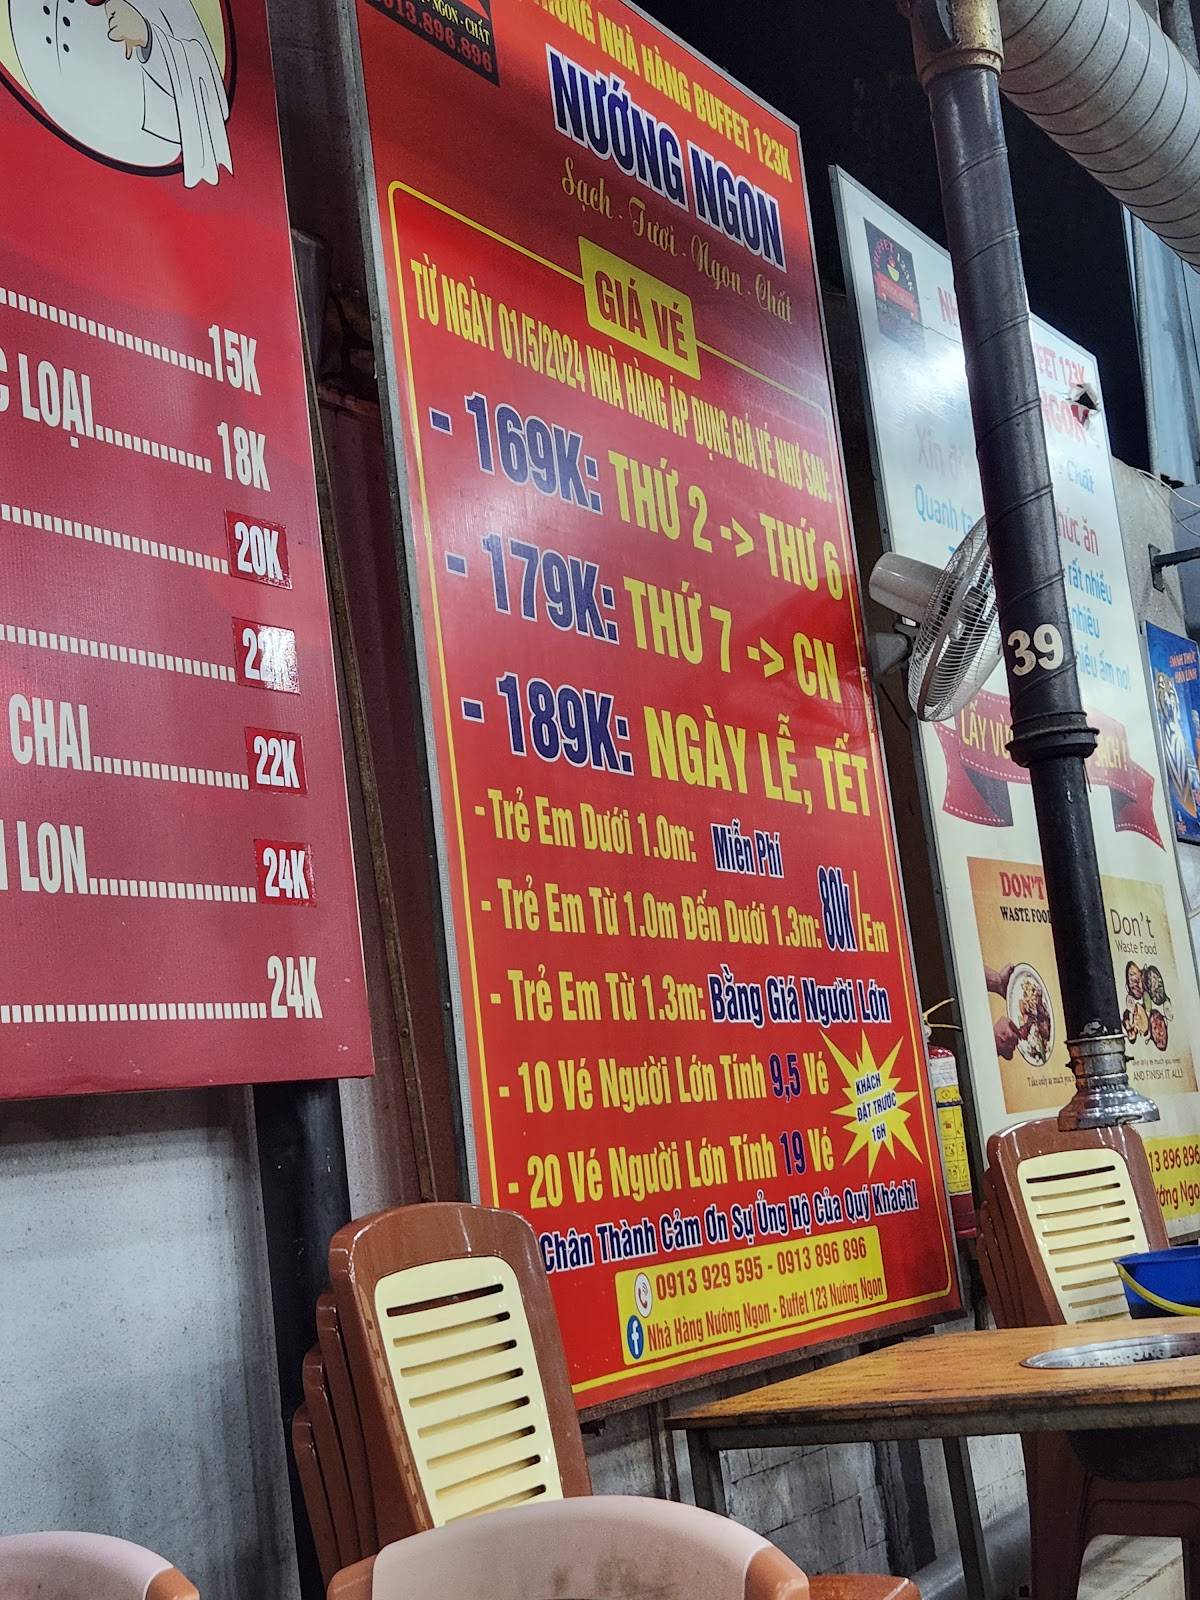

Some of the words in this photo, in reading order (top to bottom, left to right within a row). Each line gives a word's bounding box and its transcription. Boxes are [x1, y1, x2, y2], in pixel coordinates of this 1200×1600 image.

[597, 11, 640, 77] NHÀ
[641, 44, 692, 113] HÀNG
[693, 81, 751, 154] BUFFET
[753, 127, 793, 183] 123K
[545, 43, 690, 213] NƯỚNG
[687, 139, 787, 273] NGON
[561, 157, 613, 219] Sạch
[629, 196, 679, 257] Tươi
[691, 234, 744, 296] Ngon
[594, 270, 647, 341] GIÁ
[650, 302, 691, 362] VÉ
[208, 323, 262, 396] 15K
[410, 253, 440, 326] TỪ
[441, 276, 495, 352] NGÀY
[498, 303, 586, 393] 01/5/2024
[586, 344, 625, 410] NHÀ
[623, 357, 669, 430] HÀNG
[669, 375, 690, 438] ÁP
[690, 395, 733, 461] DỤNG
[731, 413, 758, 470] GIÁ
[755, 422, 776, 479] VÉ
[774, 435, 804, 491] NHƯ
[802, 448, 833, 503] SAU:
[18, 352, 95, 448] LOẠI
[217, 421, 271, 492] 18K
[464, 392, 604, 515] 169K:
[607, 449, 680, 540] THỨ
[688, 486, 713, 553] 2
[759, 512, 819, 593] THỨ
[823, 541, 844, 601] 6
[914, 483, 959, 532] Quanh
[1056, 502, 1081, 546] hức
[1083, 515, 1099, 556] ăn
[234, 521, 284, 581] 20K
[1068, 557, 1084, 592] rất
[481, 533, 619, 645] 179K:
[623, 576, 703, 665] THỨ
[710, 606, 733, 673] 7
[793, 631, 842, 704] CN
[1007, 623, 1065, 677] 39
[9, 693, 93, 773] CHAI
[253, 735, 300, 789] 22K
[496, 671, 634, 776] 189K:
[643, 704, 748, 795] NGÀY
[815, 735, 870, 817] TẾT
[17, 820, 88, 894] LON
[487, 786, 531, 843] Trẻ
[535, 795, 576, 848] Em
[579, 802, 633, 855] Dưới
[637, 812, 697, 863] 1.0m:
[710, 818, 756, 876] Miễn
[755, 829, 785, 879] Phí
[263, 848, 310, 900] 24K
[999, 871, 1045, 900] DON'T
[497, 874, 540, 932] Trẻ
[544, 882, 586, 934] Em
[588, 886, 620, 936] Từ
[623, 891, 679, 940] 1.0m
[681, 888, 723, 942] Đến
[724, 899, 770, 946] Dưới
[771, 904, 823, 949] 1.3m:
[999, 905, 1030, 922] WASTE
[1110, 908, 1155, 939] Don't
[1115, 939, 1138, 954] Waste
[1139, 945, 1158, 956] Food
[267, 956, 324, 1019] 24K
[507, 963, 553, 1022] Trẻ
[558, 971, 602, 1021] Em
[604, 971, 638, 1021] Từ
[641, 974, 707, 1022] 1.3m:
[707, 963, 765, 1030] Bằng
[764, 974, 801, 1023] Giá
[800, 976, 859, 1028] Người
[859, 981, 892, 1024] Lớn
[517, 1060, 553, 1113] 10
[559, 1055, 594, 1110] Vé
[599, 1052, 671, 1113] Người
[677, 1054, 714, 1103] Lớn
[718, 1050, 764, 1099] Tính
[769, 1052, 803, 1103] 9,5
[802, 1049, 830, 1096] Vé
[855, 1072, 883, 1096] KHÁCH
[856, 1103, 874, 1124] ĐẶT
[872, 1090, 898, 1117] TRƯỚC
[1133, 1070, 1145, 1081] AND
[871, 1123, 887, 1142] 16H
[1148, 1149, 1161, 1173] 13
[1162, 1147, 1181, 1170] 896
[1182, 1143, 1200, 1167] 896
[527, 1155, 563, 1209] 20
[568, 1150, 604, 1204] Vé
[608, 1140, 683, 1203] Người
[686, 1134, 729, 1188] Lớn
[729, 1128, 778, 1182] Tính
[778, 1127, 806, 1176] 19
[807, 1126, 835, 1172] Vé
[539, 1227, 595, 1275] Chân
[596, 1217, 658, 1264] Thành
[659, 1207, 704, 1252] Cảm
[703, 1203, 729, 1244] Ơn
[731, 1202, 755, 1246] Sự
[789, 1191, 812, 1236] Hộ
[813, 1186, 844, 1226] Của
[843, 1183, 871, 1224] Quý
[870, 1178, 920, 1218] Khách!
[655, 1268, 698, 1301] 0913
[701, 1261, 732, 1292] 929
[734, 1255, 763, 1285] 595
[776, 1246, 813, 1276] 0913
[815, 1240, 840, 1268] 896
[843, 1235, 867, 1261] 896
[647, 1320, 672, 1352] Nhà
[673, 1315, 704, 1345] Hàng
[705, 1306, 742, 1338] Nướng
[742, 1301, 772, 1330] Ngon
[778, 1290, 810, 1321] Buffet
[809, 1284, 829, 1313] 123
[859, 1275, 884, 1301] Ngon
